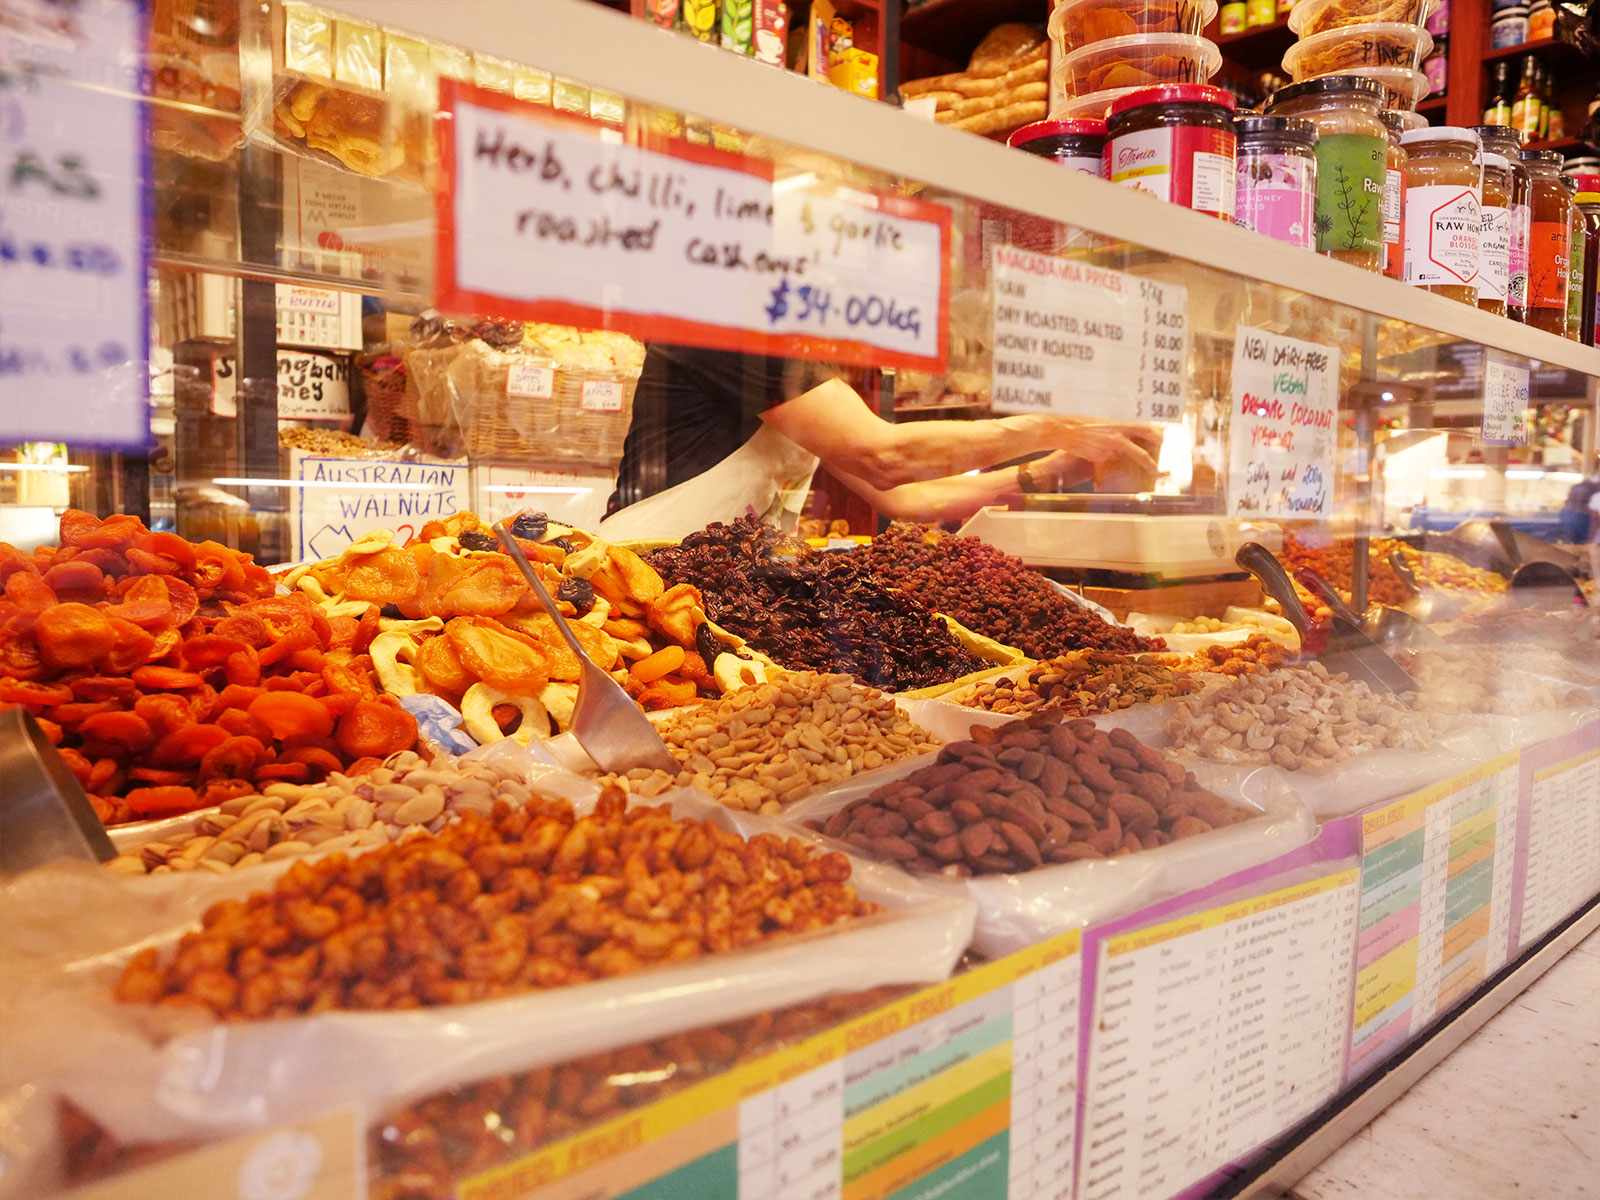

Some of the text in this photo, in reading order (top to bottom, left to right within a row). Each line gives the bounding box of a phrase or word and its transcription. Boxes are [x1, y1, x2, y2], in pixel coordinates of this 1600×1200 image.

[516, 206, 660, 251] roasted
[829, 213, 903, 256] garlic
[1435, 221, 1464, 231] RAW
[314, 462, 455, 487] AUSTRALIAN
[339, 490, 458, 519] WALNUTS
